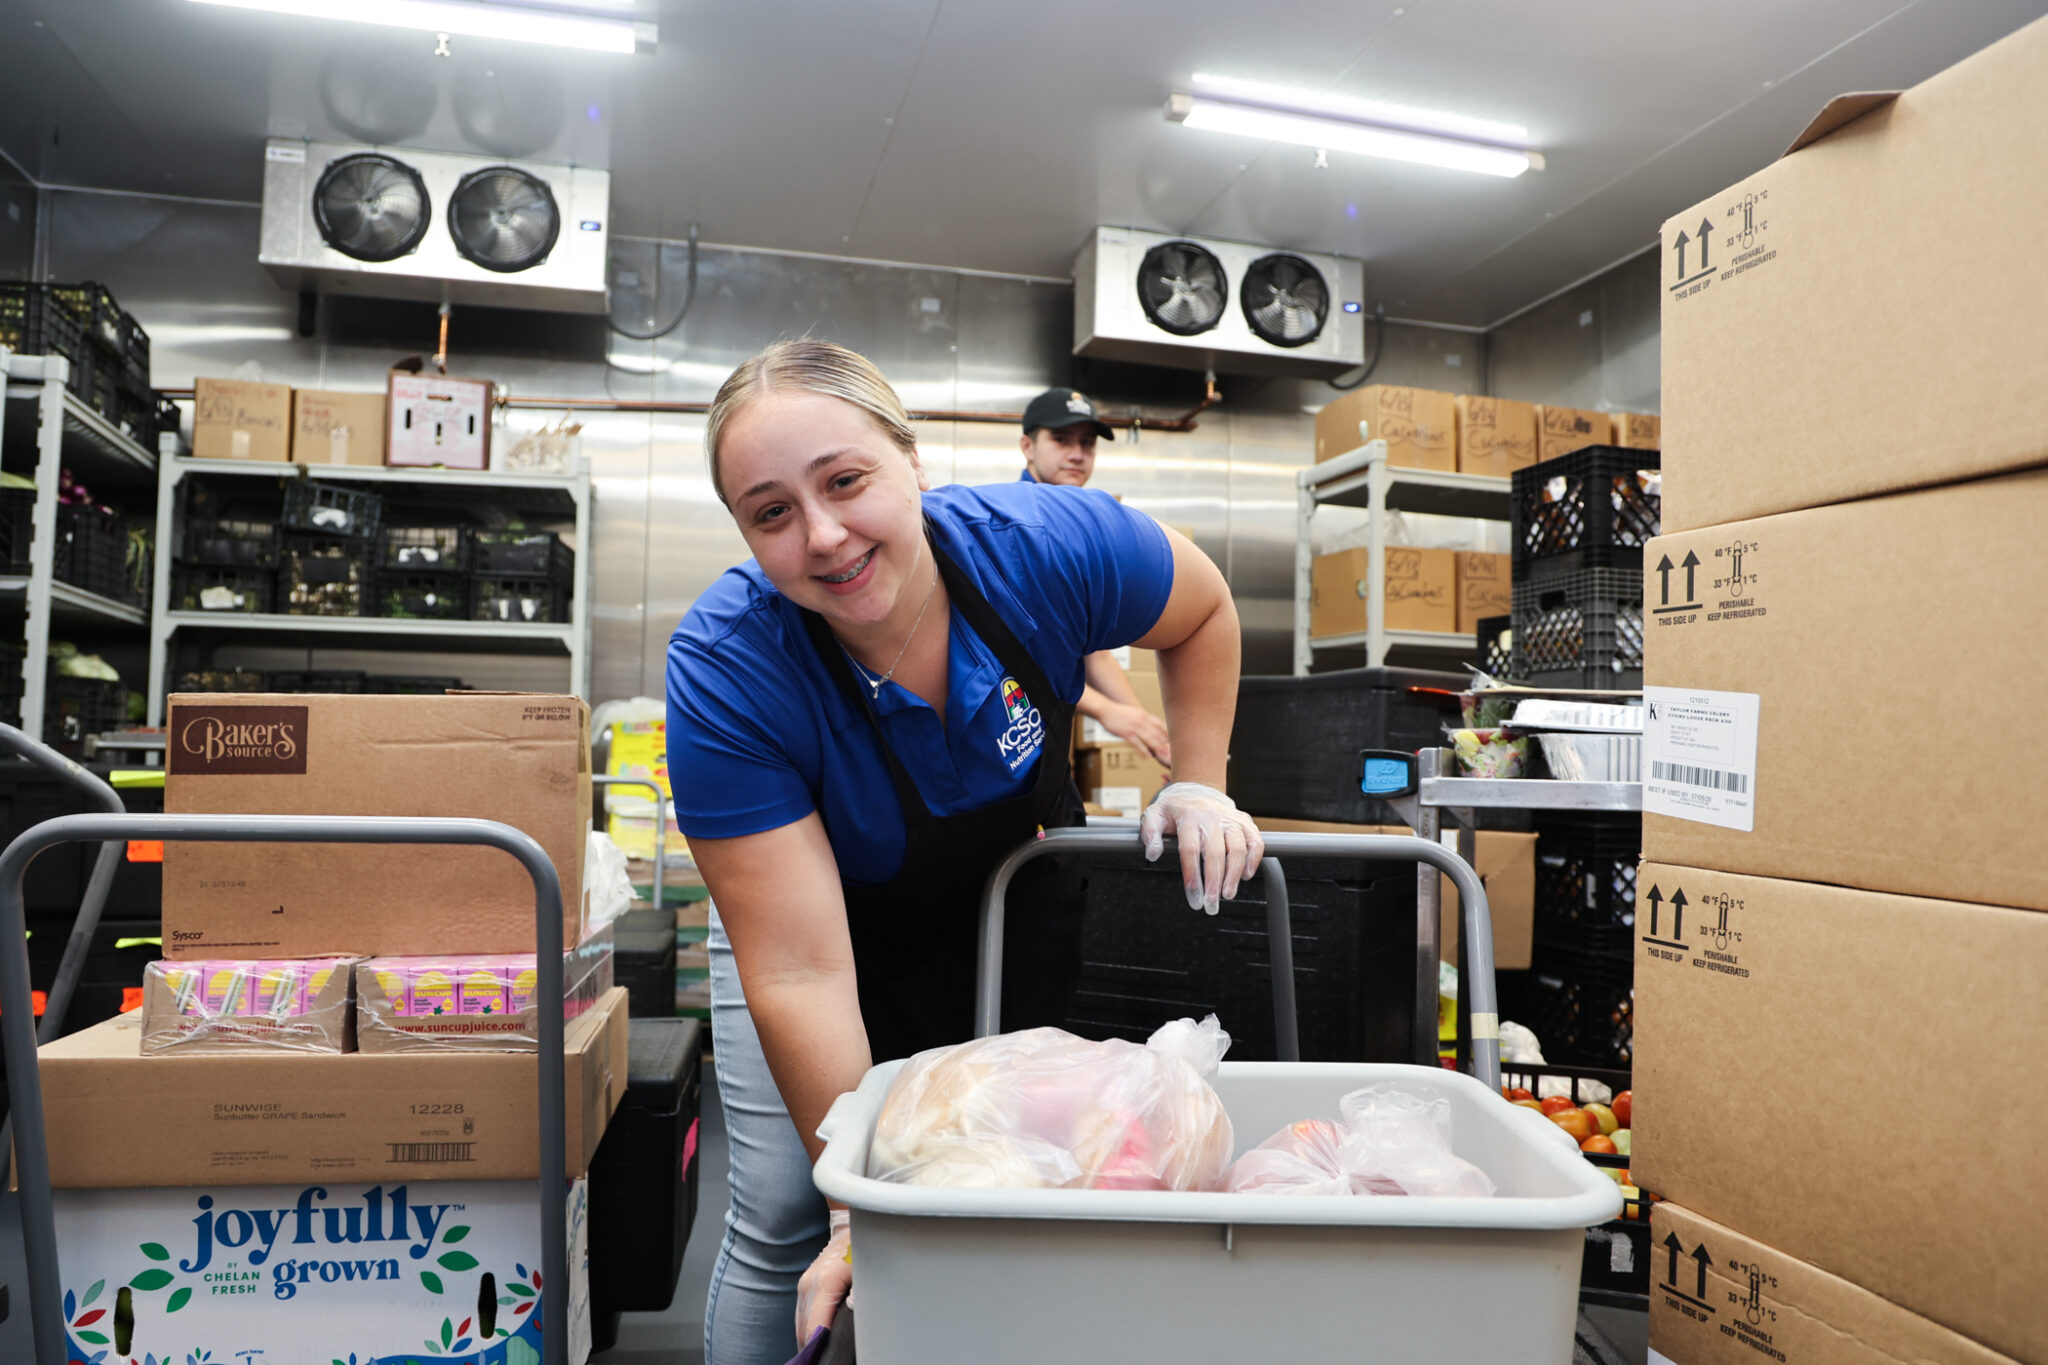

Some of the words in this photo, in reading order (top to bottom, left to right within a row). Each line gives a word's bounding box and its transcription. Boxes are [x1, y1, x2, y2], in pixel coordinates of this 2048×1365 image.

[1754, 195, 1759, 203] 5
[1727, 207, 1735, 217] 40
[1726, 237, 1734, 247] 33
[1731, 244, 1765, 266] PERISHABLE
[1721, 269, 1735, 281] KEEP
[1735, 250, 1777, 275] REFRIGERATED
[1675, 290, 1687, 302] THIS
[1689, 284, 1702, 296] SIDE
[1703, 279, 1711, 289] UP
[1714, 549, 1723, 557] 40
[1743, 544, 1749, 553] 5
[1714, 579, 1722, 588] 33
[1719, 598, 1754, 609] PERISHABLE
[1707, 612, 1721, 621] KEEP
[1723, 607, 1767, 620] REFRIGERATED
[1659, 618, 1672, 627] THIS
[1673, 616, 1687, 625] SIDE
[1688, 614, 1697, 623] UP
[543, 706, 571, 714] FROZEN
[1649, 703, 1657, 720] K
[1016, 736, 1032, 754] Food
[1031, 726, 1042, 740] and
[227, 746, 272, 758] source
[1009, 744, 1035, 771] Nutrition
[1667, 789, 1681, 797] USED
[1702, 895, 1710, 904] 40
[1730, 899, 1735, 908] 5
[172, 930, 202, 941] Sysco
[1700, 926, 1708, 935] 33
[1647, 947, 1660, 958] THIS
[1661, 950, 1673, 961] SIDE
[1675, 954, 1683, 963] UP
[1704, 950, 1738, 965] PERISHABLE
[1693, 958, 1706, 968] KEEP
[1707, 961, 1749, 978] REFRIGERATED
[214, 1104, 282, 1112] SUNWISE
[409, 1103, 465, 1115] 12228
[214, 1112, 260, 1121] Sunbutter
[262, 1112, 298, 1120] GRAPE
[179, 1185, 450, 1273] joyfully
[1729, 1259, 1738, 1271] 40
[203, 1271, 261, 1282] CHELAN
[272, 1258, 401, 1300] grown
[1762, 1273, 1767, 1283] 5
[212, 1284, 256, 1295] FRESH
[1728, 1292, 1737, 1303] 33
[1665, 1296, 1680, 1311] THIS
[1681, 1304, 1697, 1319] SIDE
[1698, 1312, 1709, 1324] UP
[1733, 1319, 1773, 1344] PERISHABLE
[1720, 1324, 1736, 1337] KEEP
[1738, 1331, 1786, 1363] REFRIGERATED
